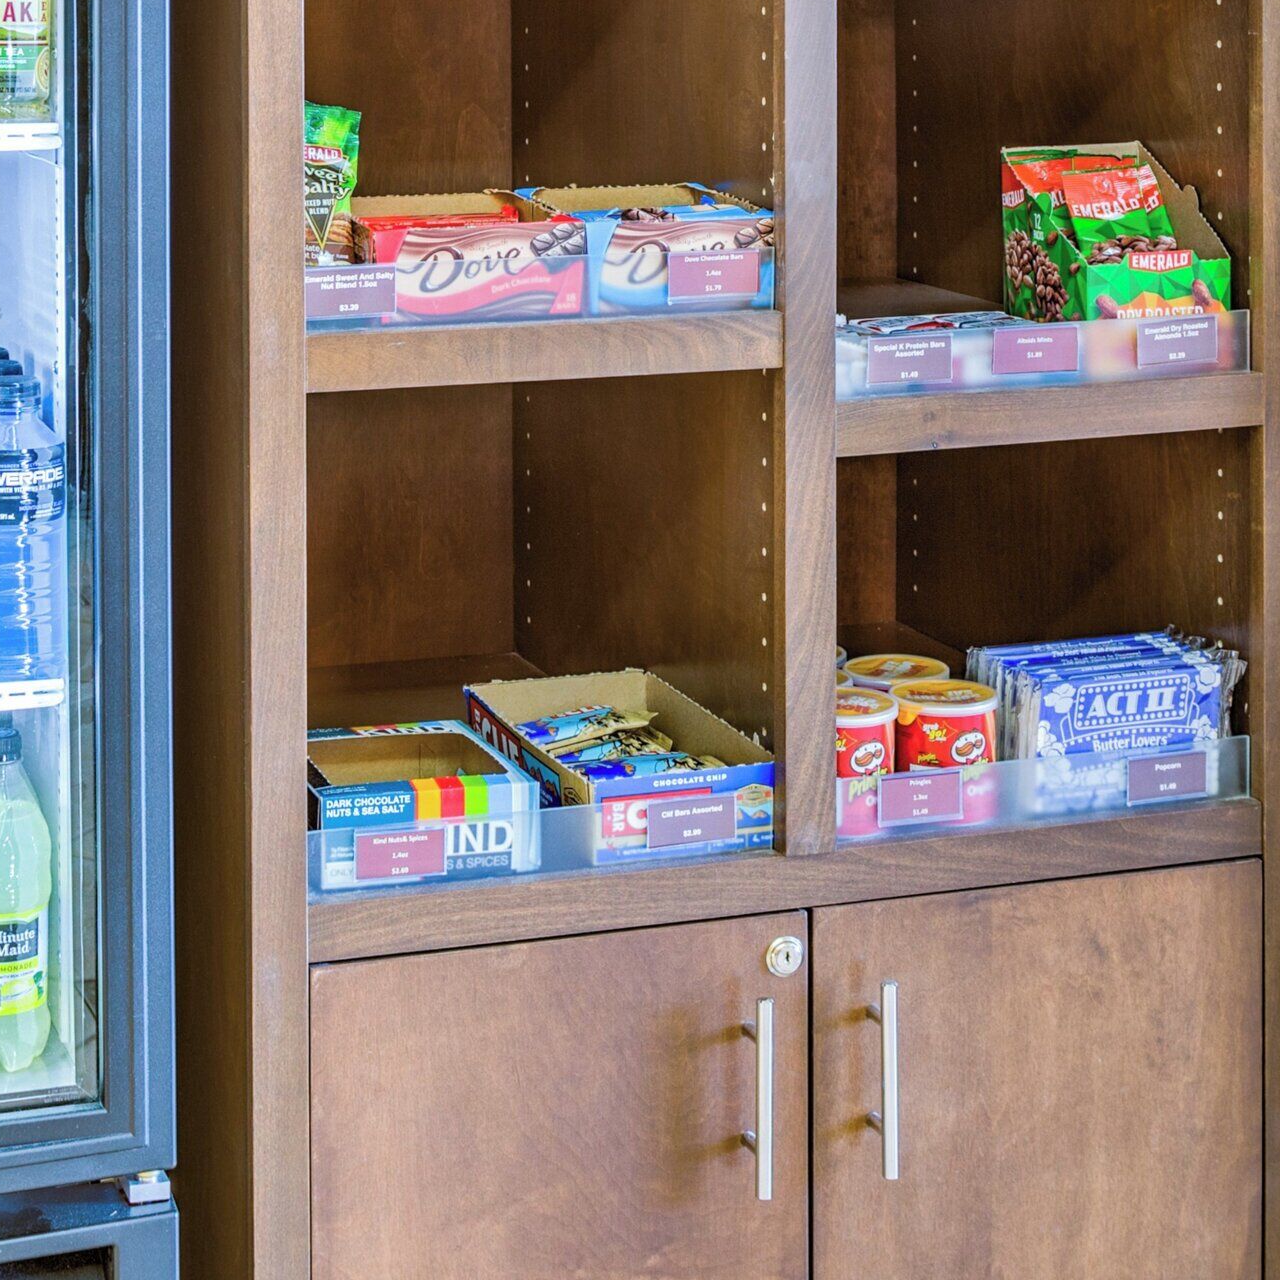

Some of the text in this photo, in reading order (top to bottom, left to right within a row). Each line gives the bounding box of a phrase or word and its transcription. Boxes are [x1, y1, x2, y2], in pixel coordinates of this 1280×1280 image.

[1072, 196, 1141, 219] EMERALD
[1131, 252, 1189, 270] EMERALD
[1086, 690, 1143, 718] ACT
[1092, 734, 1169, 752] Butter Lovers
[326, 794, 410, 809] DARK CHOCOLATE
[326, 804, 405, 817] NUTS & SEA SALT
